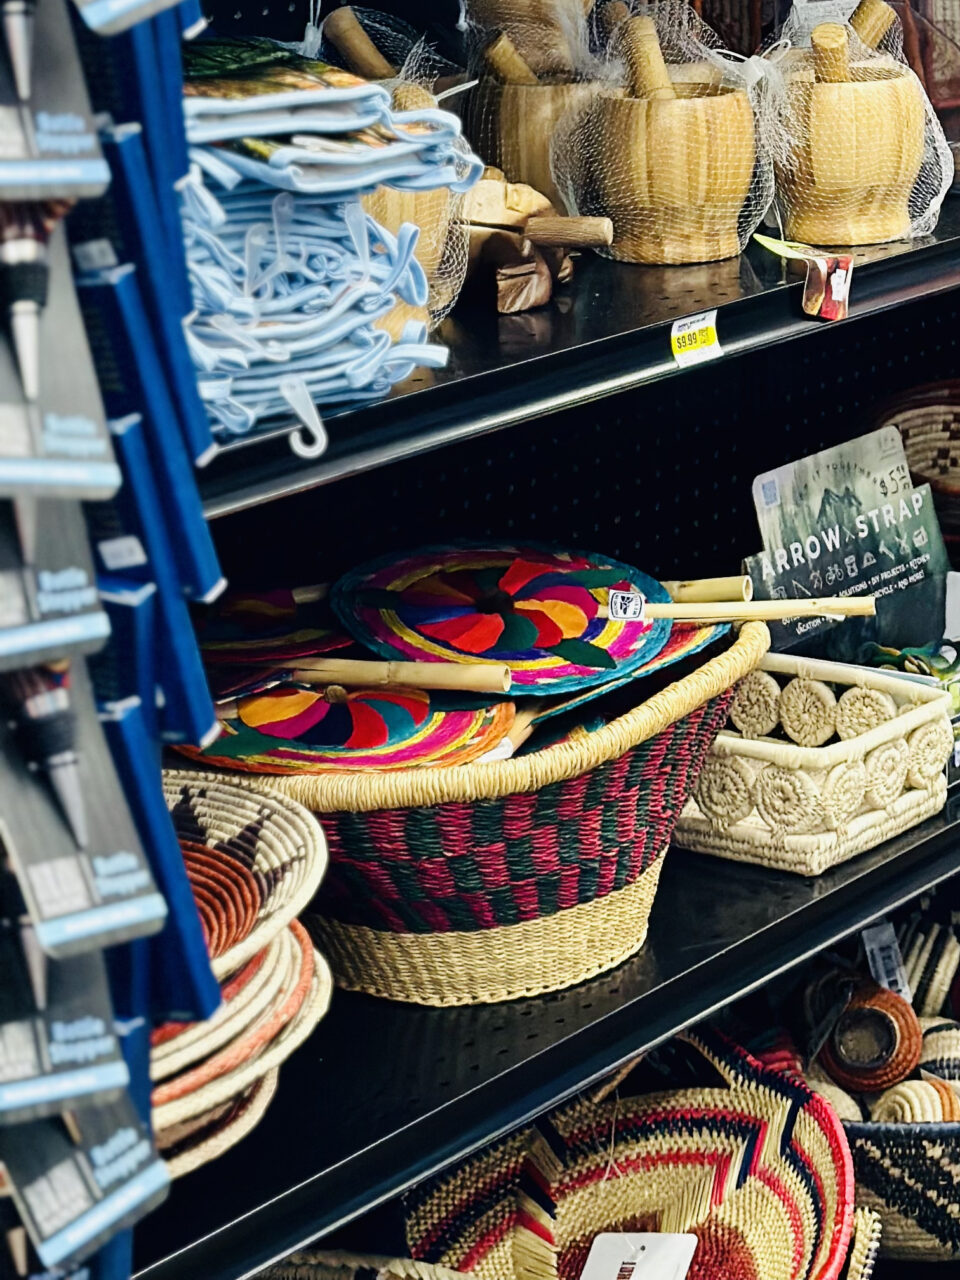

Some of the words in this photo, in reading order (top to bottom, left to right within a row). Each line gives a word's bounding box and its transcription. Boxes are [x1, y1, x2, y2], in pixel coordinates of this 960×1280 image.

[676, 332, 697, 350] $9.99
[761, 524, 841, 581] ARROW
[855, 492, 925, 539] STRAP
[880, 564, 906, 582] PROJECTS
[795, 619, 822, 635] VACATION
